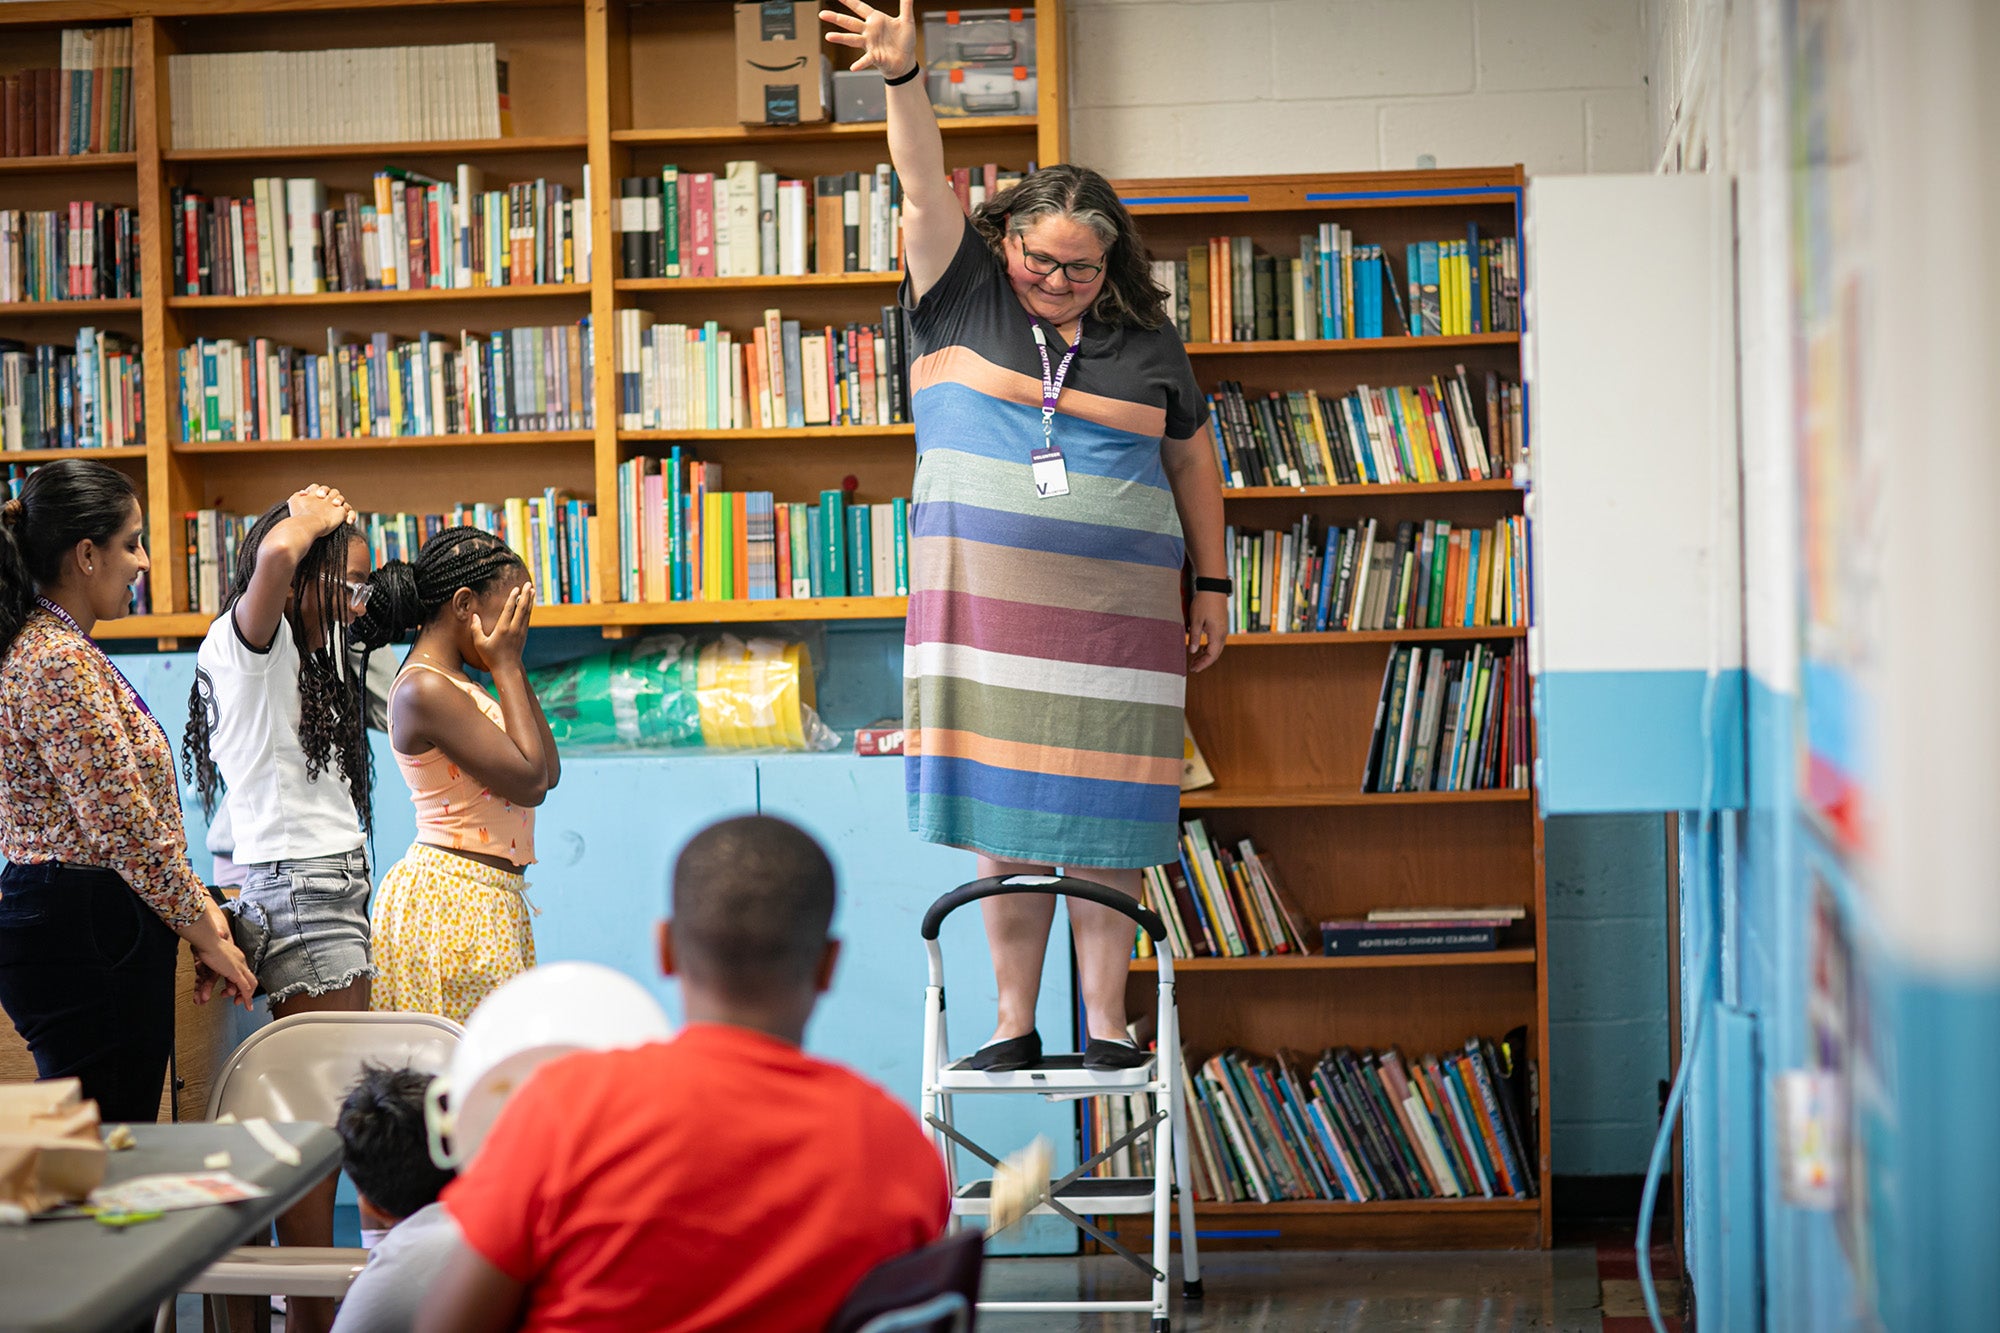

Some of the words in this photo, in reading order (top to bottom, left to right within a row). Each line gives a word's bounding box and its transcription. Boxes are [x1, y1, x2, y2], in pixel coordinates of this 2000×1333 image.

[1039, 345, 1052, 398] VOLUNTEER
[1051, 352, 1075, 399] VOLUNTEER
[36, 596, 85, 637] VOLUNTEER
